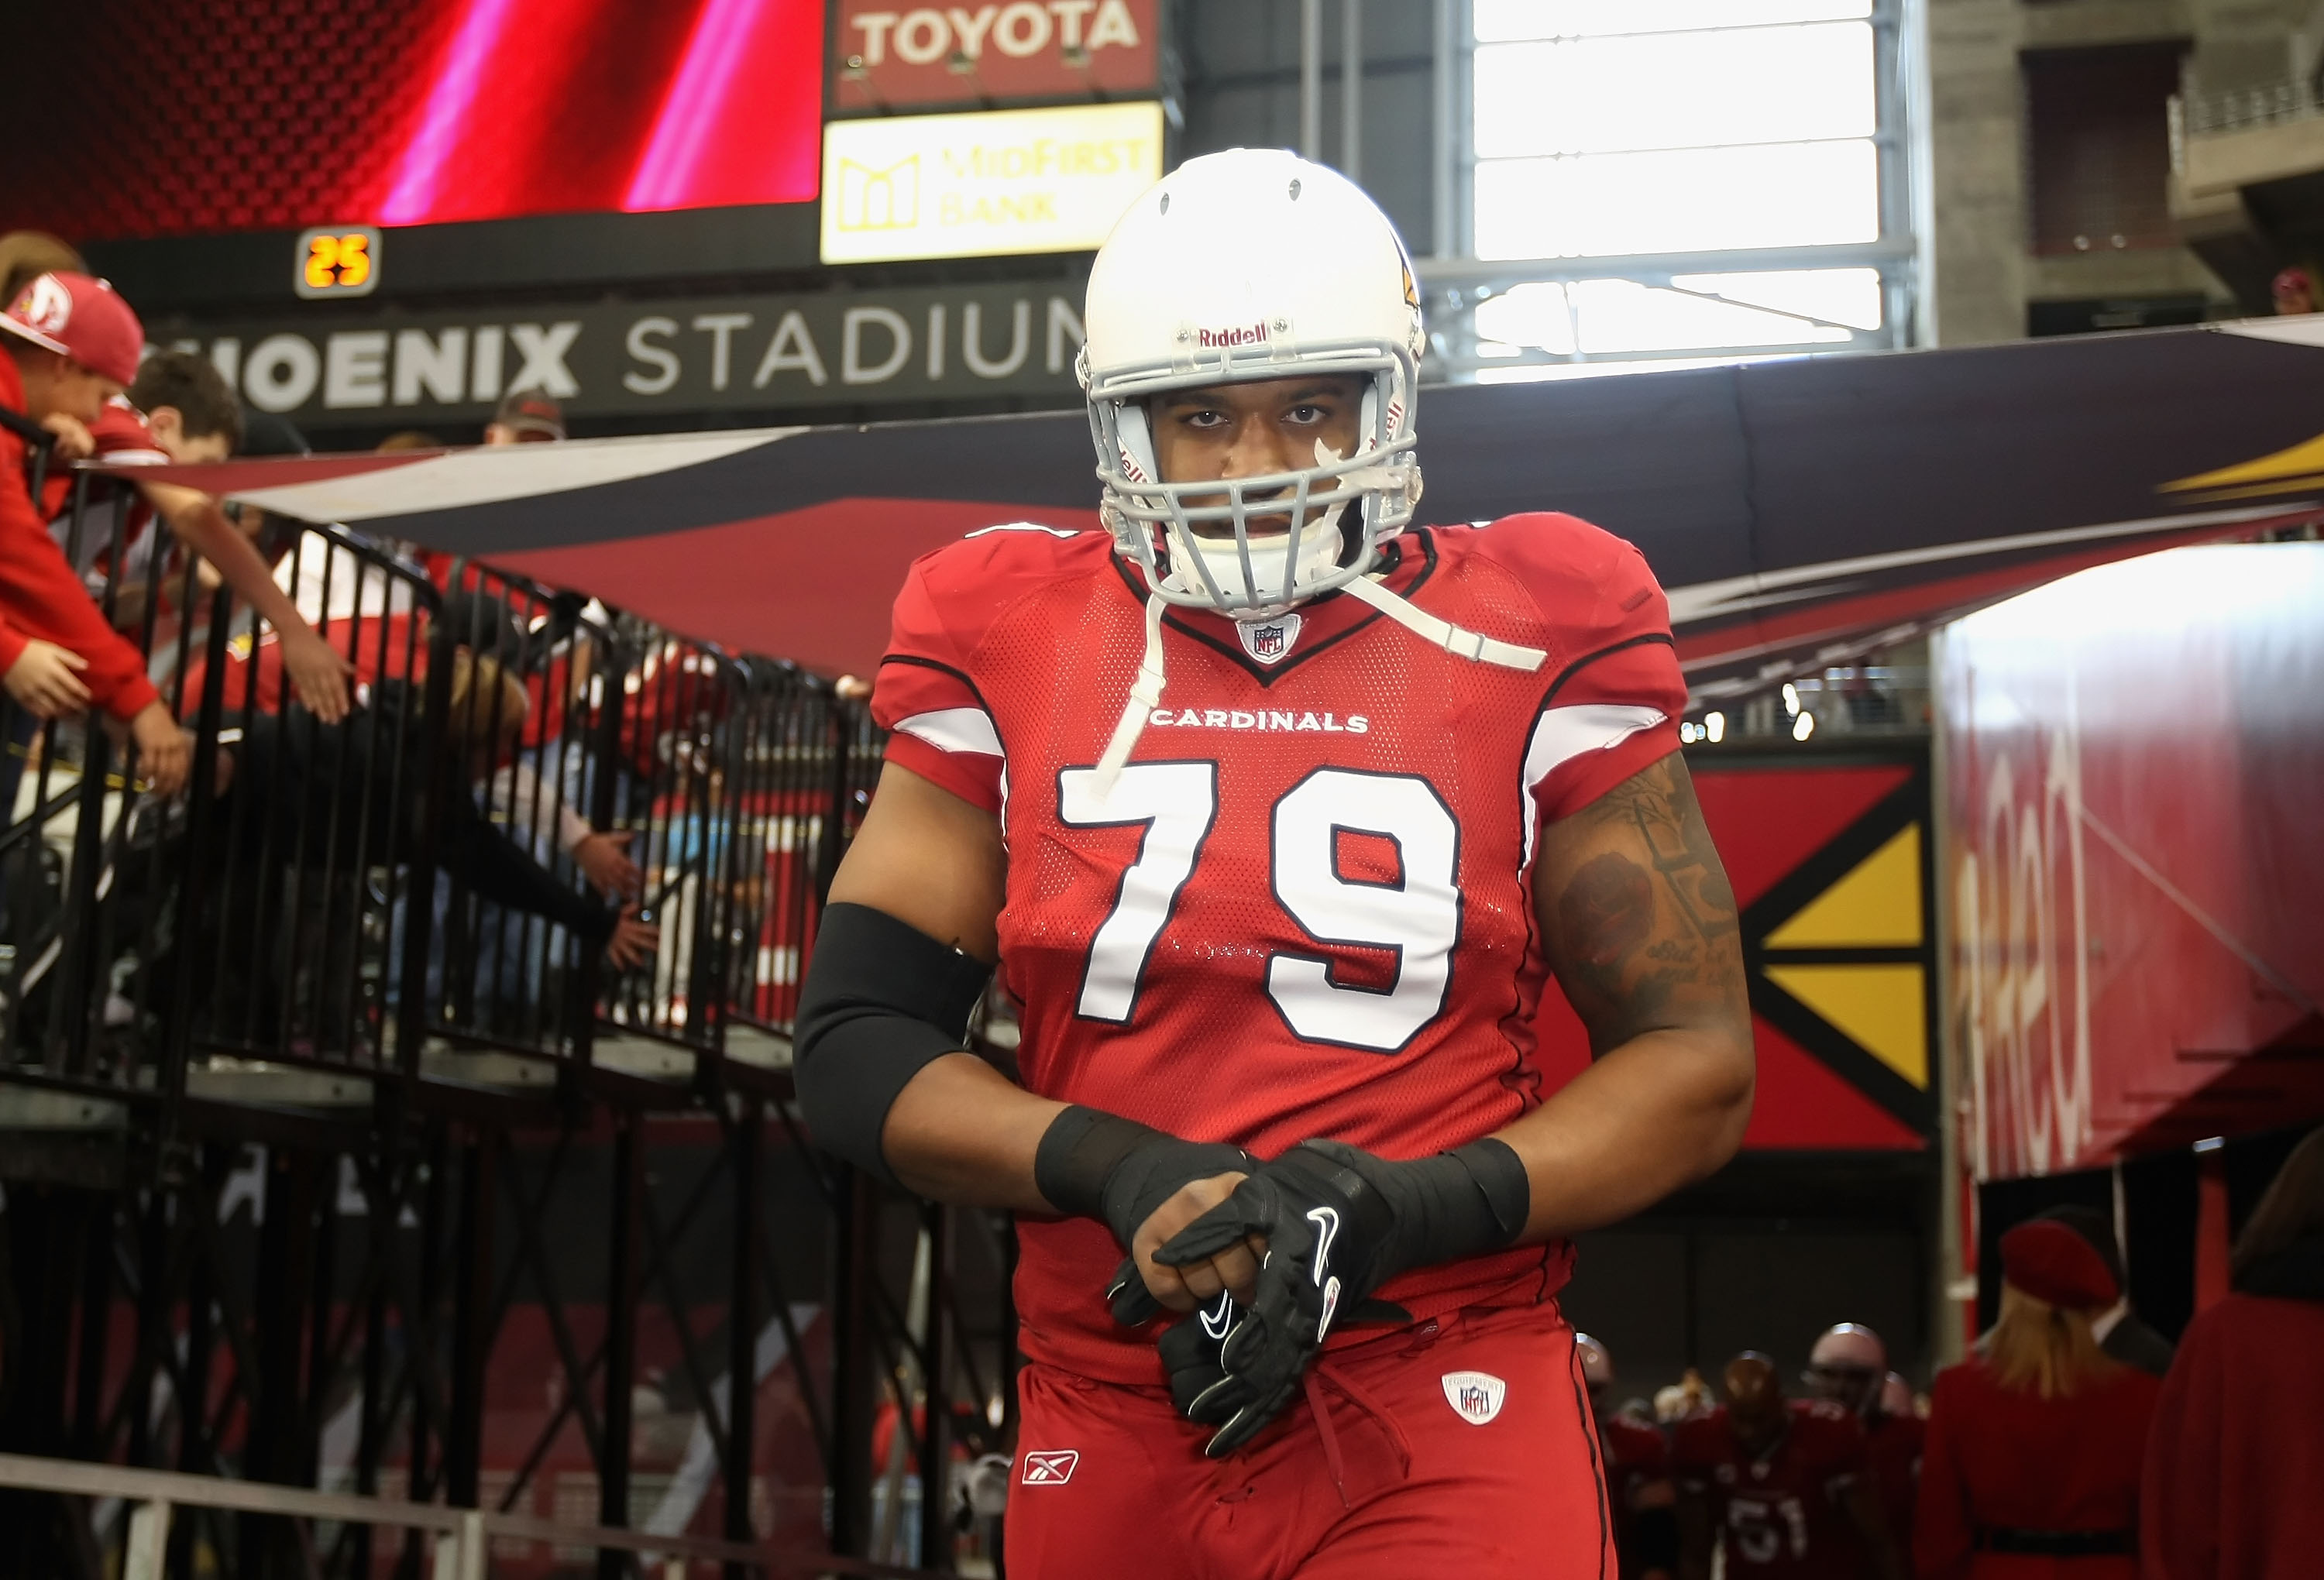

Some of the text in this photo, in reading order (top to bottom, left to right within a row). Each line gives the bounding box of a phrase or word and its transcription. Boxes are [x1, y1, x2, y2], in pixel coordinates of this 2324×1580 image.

[851, 0, 1140, 65] TOYOTA
[939, 191, 1057, 225] BANK
[305, 234, 370, 288] 25
[1199, 321, 1267, 347] Riddell
[1257, 638, 1282, 654] NFL
[1150, 709, 1369, 734] CARDINALS
[1057, 760, 1465, 1054] 79
[1464, 1399, 1487, 1414] NFL
[1728, 1497, 1808, 1564] 51
